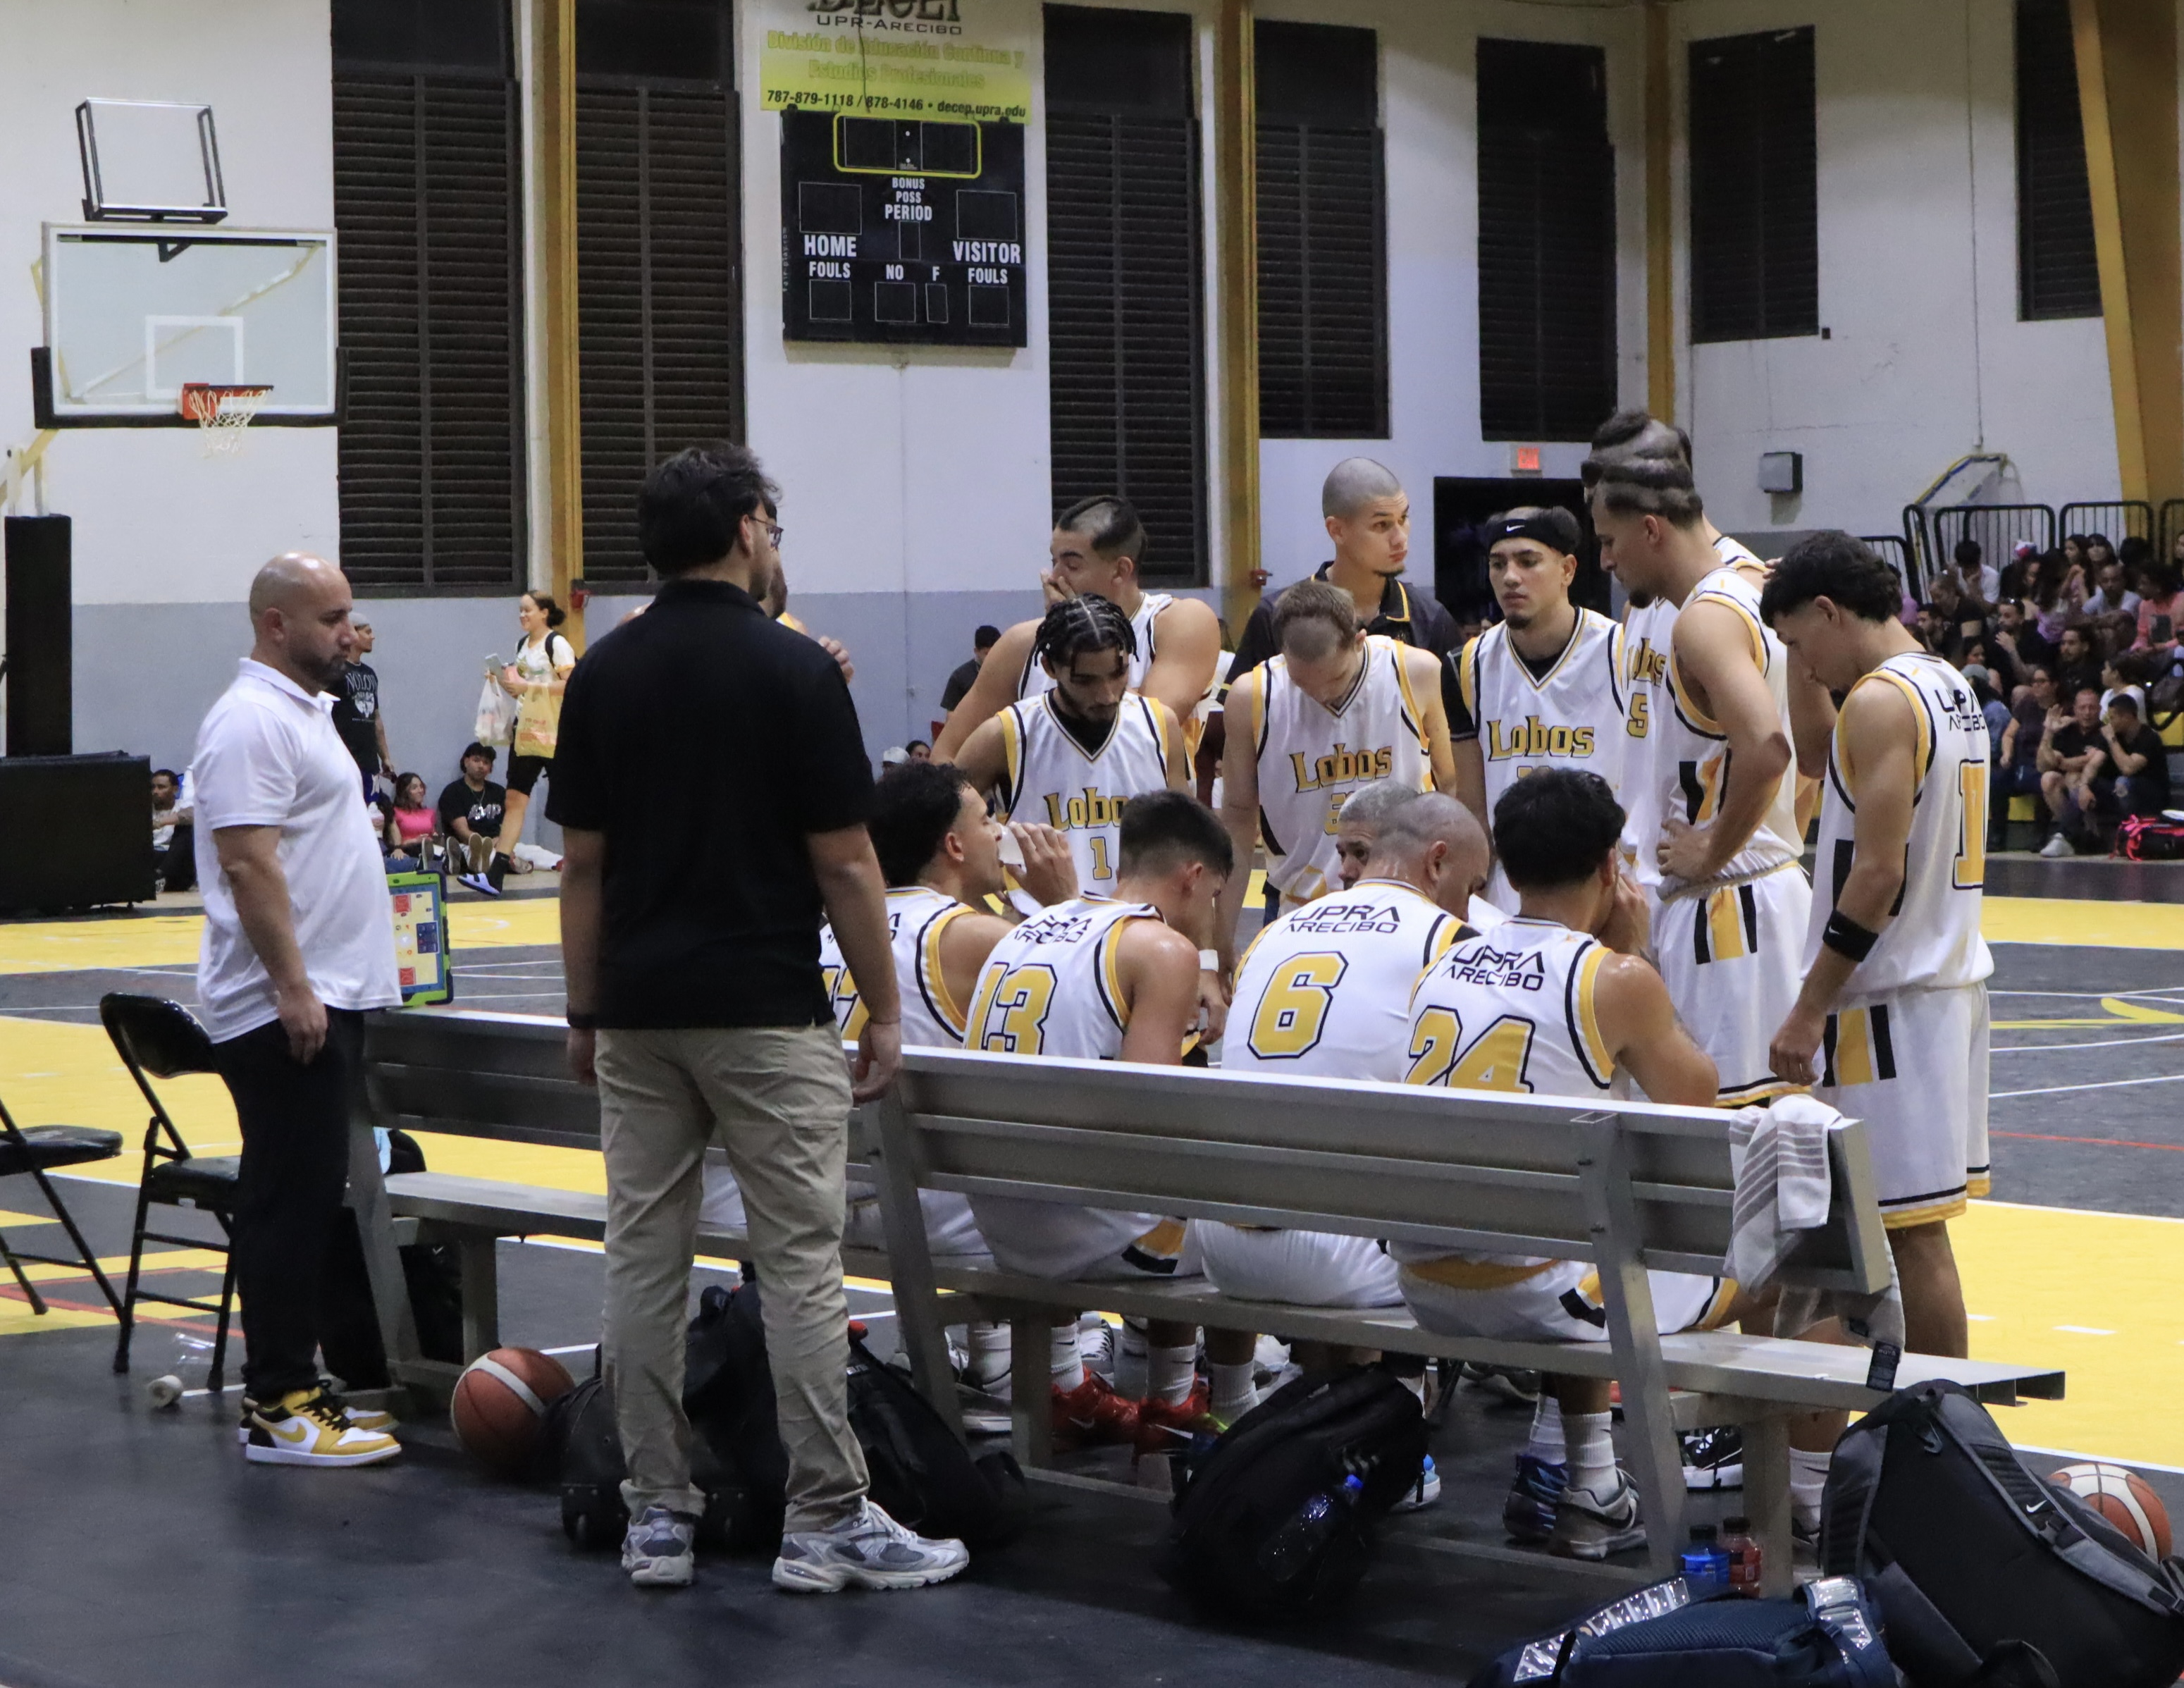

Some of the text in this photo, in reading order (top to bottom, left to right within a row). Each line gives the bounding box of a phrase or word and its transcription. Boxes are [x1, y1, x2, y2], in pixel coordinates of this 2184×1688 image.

[817, 14, 962, 35] UPR-ARECIBO
[767, 90, 853, 106] 787-879-1118
[866, 96, 923, 111] 878-4146
[892, 178, 925, 190] BONUS
[895, 191, 922, 203] POSS
[884, 204, 933, 221] PERIOD
[803, 234, 857, 257] HOME
[952, 240, 1021, 264] VISITOR
[808, 261, 851, 278] FOULS
[885, 264, 904, 281] NO
[932, 266, 940, 281] F
[968, 268, 1008, 284] FOULS
[1486, 715, 1595, 762] Lobos
[1289, 743, 1393, 794] Lobos
[1042, 787, 1129, 832] Lobo
[1090, 836, 1112, 880] 1
[1289, 904, 1401, 923] UPRA
[1280, 921, 1399, 935] ARECIBO
[1451, 944, 1546, 973] UPRA
[1440, 964, 1544, 991] ARECIBO
[965, 961, 1058, 1055] 13
[1247, 951, 1349, 1060] 6
[1405, 1004, 1536, 1093] 24
